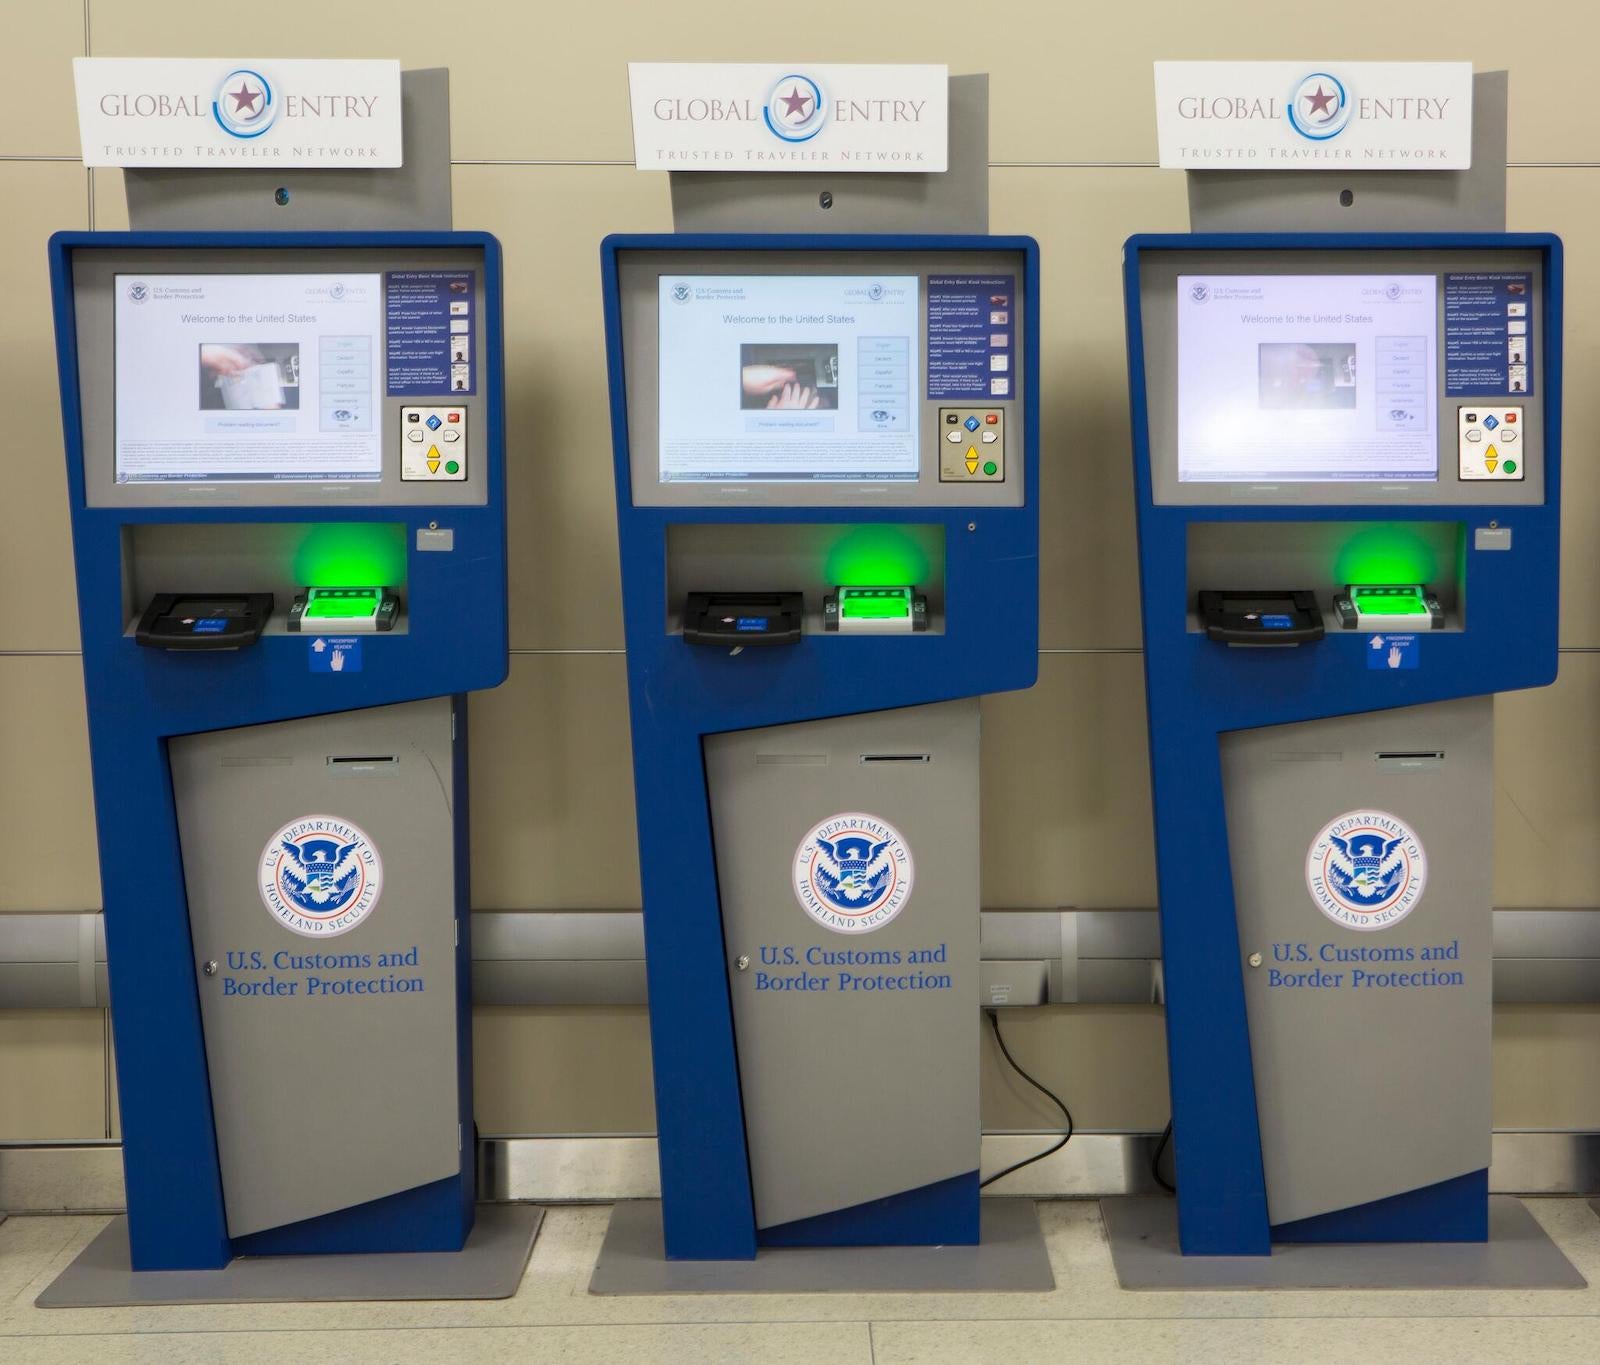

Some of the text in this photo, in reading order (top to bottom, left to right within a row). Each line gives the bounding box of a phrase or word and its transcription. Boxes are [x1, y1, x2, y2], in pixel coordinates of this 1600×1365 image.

[99, 94, 379, 118] GLOBAL ENTRY
[653, 98, 926, 122] GLOBAL ENTRY
[1177, 97, 1450, 120] GLOBAL ENTRY
[181, 314, 317, 324] Welcome to the United States
[722, 314, 856, 324] Welcome to the United States
[1240, 314, 1374, 324] Welcome to the United States
[265, 821, 376, 867] U.S. DEPARTMENT OF
[799, 819, 907, 865] U.S. DEPARTMENT OF
[1313, 816, 1420, 862] U.S. DEPARTMENT OF
[265, 881, 376, 932] HOMELAND SECURITY
[800, 878, 907, 928] HOMELAND SECURITY
[1313, 875, 1420, 925] HOMELAND SECURITY
[226, 947, 418, 970] U.S. Customs and
[760, 943, 947, 965] U.S. Customs and
[1272, 940, 1459, 962] U.S. Customs and
[223, 975, 425, 996] Border Protection
[756, 971, 952, 991] Border Protection
[1268, 967, 1464, 988] Border Protection
